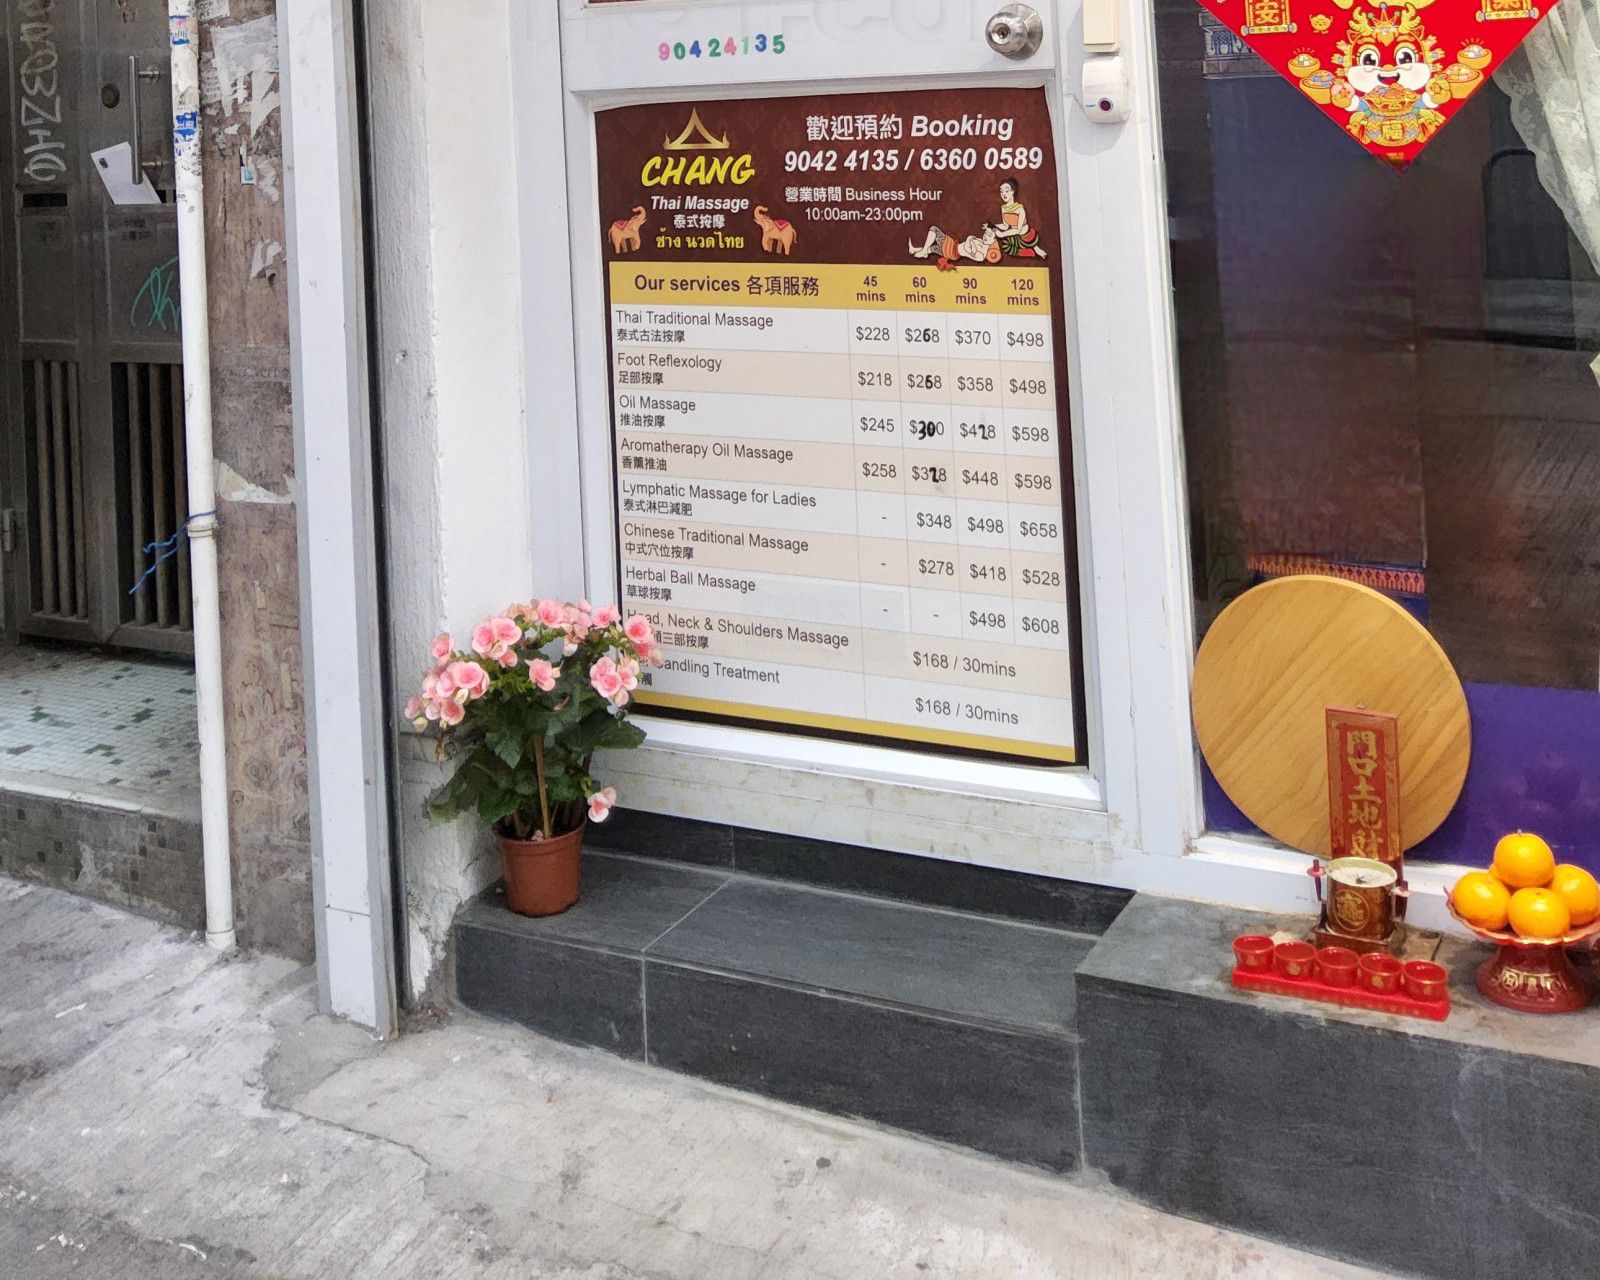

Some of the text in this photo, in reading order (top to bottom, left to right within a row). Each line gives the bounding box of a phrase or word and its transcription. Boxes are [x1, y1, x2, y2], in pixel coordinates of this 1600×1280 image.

[807, 115, 1013, 141] 歡迎預約 Booking
[642, 154, 755, 186] CHANG
[785, 152, 837, 172] 9042
[844, 151, 899, 171] 4135
[920, 149, 976, 170] 6360
[984, 147, 1042, 169] 0589
[651, 195, 749, 212] Thai Massage
[785, 187, 942, 203] 營業時間 Business Hour
[673, 214, 725, 230] 泰式按摩
[805, 206, 923, 223] 10:00am-23:00pm
[656, 227, 744, 249] ช้าง นวดไทย
[634, 275, 819, 296] Our services 各項服務
[863, 276, 1033, 290] 45 60 90 120
[857, 291, 1039, 306] mins mins mins mins
[616, 311, 773, 329] Thai Traditional Massage
[617, 329, 685, 343] 泰式古法按摩
[856, 326, 890, 341] $228
[955, 330, 991, 345] $370
[1007, 331, 1044, 347] $498
[618, 353, 722, 371] Foot Reflexology
[619, 372, 663, 384] 足部按摩
[858, 372, 892, 386] $218
[958, 376, 993, 391] $358
[1009, 378, 1046, 394] $498
[619, 395, 696, 413] Oil Massage
[620, 414, 665, 427] 推油按摩
[860, 417, 894, 432] $245
[1012, 426, 1049, 442] $598
[621, 438, 793, 463] Aromatherapy Oil Massage
[863, 462, 897, 478] $258
[962, 469, 998, 486] $448
[1014, 473, 1052, 489] $598
[623, 481, 816, 507] Lymphatic Massage for Ladies
[624, 498, 692, 516] 泰式淋巴減肥
[917, 513, 1057, 538] $348 $498 $658
[624, 523, 808, 553] Chinese Traditional Massage
[625, 542, 693, 560] 中式穴位按摩
[626, 566, 755, 593] Herbal Ball Massage
[919, 559, 1060, 586] $278 $418 $528
[626, 585, 672, 601] 草球按摩
[627, 609, 849, 649] Had, Neck & Shoulders Massage
[969, 611, 1059, 634] $498 $608
[713, 663, 780, 684] Treatment
[913, 651, 948, 669] $168
[963, 658, 1016, 677] 30mins
[915, 698, 950, 716] $168
[965, 704, 1019, 725] 30mins
